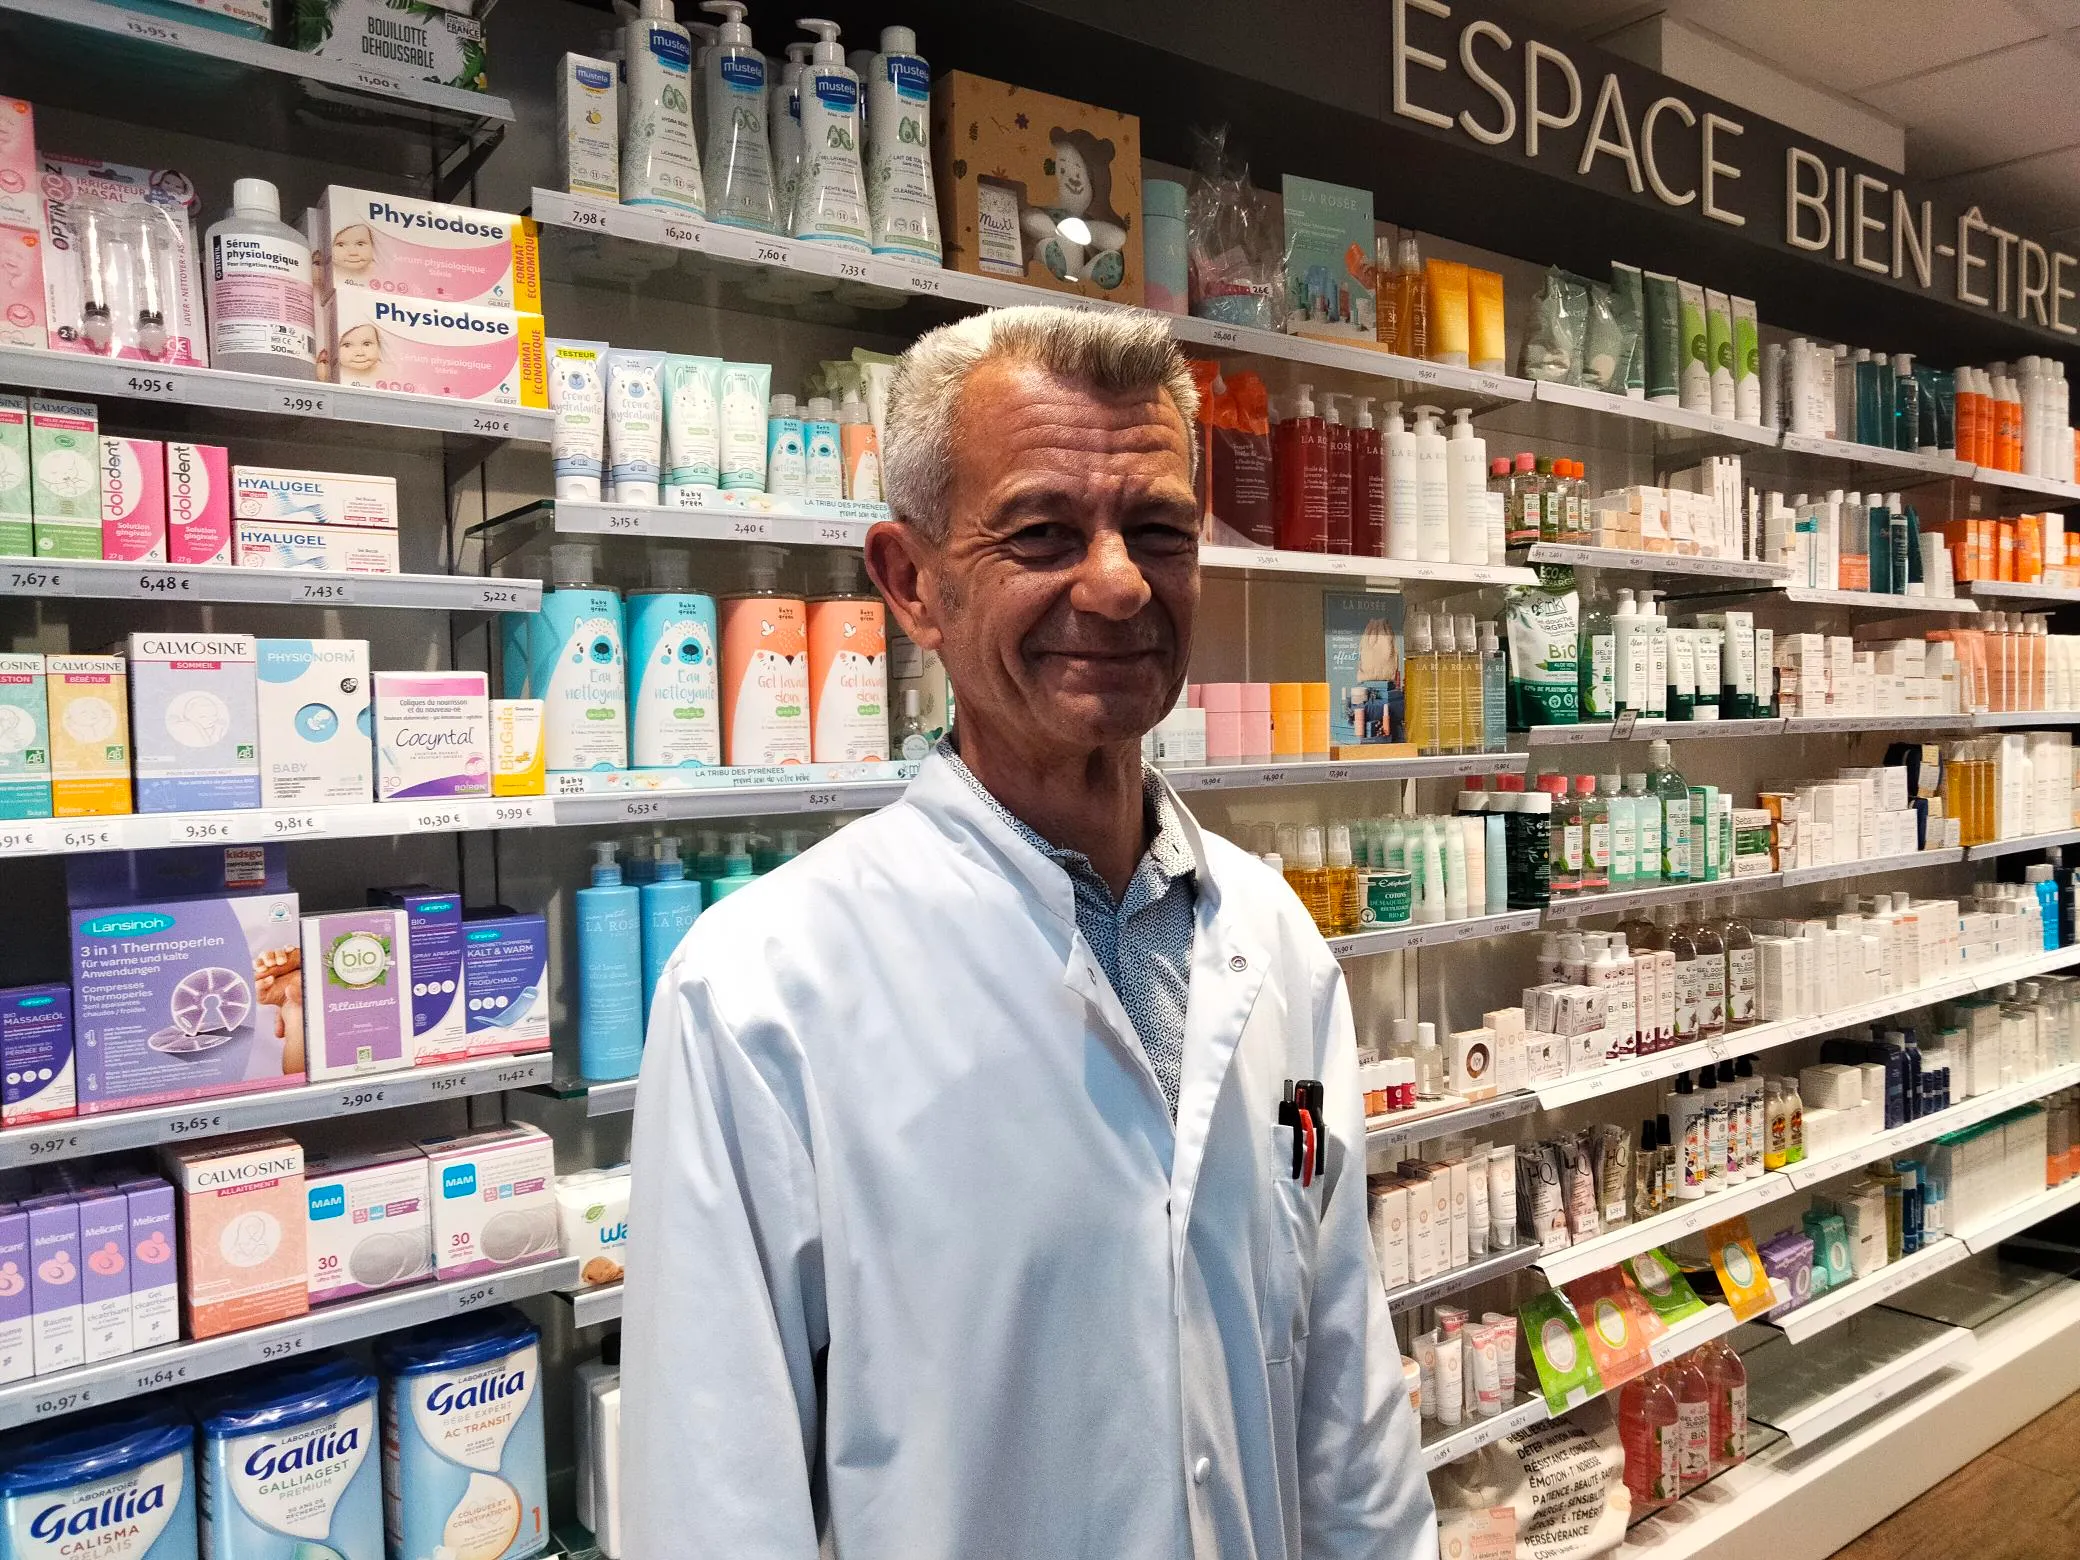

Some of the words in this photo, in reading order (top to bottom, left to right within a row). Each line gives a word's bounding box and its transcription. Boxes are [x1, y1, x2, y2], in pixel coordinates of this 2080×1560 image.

[368, 16, 428, 47] BOUILLOTTE
[447, 22, 480, 39] FRANCE
[362, 36, 435, 69] DEHOUSSABLE
[578, 69, 608, 82] mustela
[723, 61, 763, 78] mustela
[818, 81, 856, 96] mustela
[1393, 0, 1746, 227] ESPACE
[1786, 146, 2080, 335] BIEN-ÊTRE
[77, 178, 146, 197] IRRIGATEUR
[78, 186, 127, 204] NASAL
[369, 202, 503, 239] Physiodose
[572, 210, 597, 225] 7,98
[665, 228, 692, 243] 16,20
[226, 239, 260, 250] Sérum
[227, 249, 299, 267] physiologique
[758, 248, 778, 262] 7,60
[516, 244, 525, 284] FORMAT
[527, 232, 537, 299] ÉCONOMIQUE
[376, 303, 509, 336] Physiodose
[523, 343, 531, 381] FORMAT
[533, 329, 541, 395] ÉCONOMIQUE
[558, 350, 596, 359] TESTEUR
[128, 377, 161, 393] 4,95
[33, 403, 95, 418] CALMOSINE
[283, 397, 312, 411] 2,99
[473, 419, 499, 431] 2,40
[102, 441, 120, 516] dolodent
[173, 446, 191, 521] dolodent
[238, 478, 324, 494] HYALUGEL
[681, 489, 702, 500] Baby
[610, 516, 630, 528] 3,15
[734, 523, 755, 534] 2,40
[241, 531, 327, 546] HYALUGEL
[821, 529, 840, 539] 2,25
[12, 574, 46, 587] 7,67
[140, 577, 176, 591] 6,48
[304, 585, 333, 598] 7,43
[483, 591, 508, 603] 5,22
[143, 641, 248, 656] CALMOSINE
[267, 652, 355, 664] PHYSIONORM
[1333, 651, 1358, 664] offert
[52, 661, 122, 672] CALMOSINE
[176, 662, 215, 670] SOMMEIL
[396, 727, 475, 751] Cocyntal
[498, 706, 515, 771] BioGaia
[560, 776, 583, 789] Baby
[809, 794, 829, 805] 8,25
[496, 808, 523, 820] 9,99
[627, 802, 650, 815] 6,53
[274, 818, 302, 832] 9,81
[418, 815, 450, 827] 10,30
[186, 825, 216, 837] 9,36
[65, 833, 95, 845] 6,15
[226, 849, 263, 860] kidsgo
[92, 917, 165, 933] Lansinoh
[81, 945, 91, 957] 3
[94, 945, 107, 956] in
[111, 943, 118, 955] 1
[121, 935, 224, 957] Thermoperlen
[467, 947, 492, 957] KALT
[493, 946, 502, 955] &
[503, 944, 534, 954] WARM
[82, 957, 98, 969] für
[100, 957, 138, 968] warme
[140, 954, 161, 964] und
[163, 951, 188, 962] kalte
[342, 950, 377, 968] bio
[82, 965, 160, 980] Anwendungen
[82, 982, 145, 995] Compresses
[83, 989, 153, 1003] Thermoperles
[328, 996, 396, 1013] Allaitement
[4, 1011, 66, 1026] MASSAGEÖL
[498, 1070, 525, 1081] 11,42
[432, 1078, 457, 1089] 11,51
[342, 1092, 373, 1106] 2,90
[170, 1115, 208, 1132] 13,65
[30, 1139, 64, 1155] 9,97
[198, 1157, 297, 1186] CALMOSINE
[221, 1180, 276, 1197] ALLAITEMENT
[446, 1175, 474, 1188] MAM
[312, 1196, 343, 1209] MAM
[133, 1214, 170, 1228] Melicare
[85, 1223, 124, 1237] Melicare
[35, 1231, 76, 1246] Melicare
[451, 1232, 470, 1246] 30
[318, 1255, 338, 1269] 30
[459, 1289, 485, 1307] 5,50
[264, 1341, 292, 1358] 9,23
[137, 1368, 173, 1388] 11,64
[458, 1366, 506, 1384] LABORATOIRE
[427, 1370, 525, 1415] Gallia
[36, 1394, 77, 1414] 10,97
[474, 1401, 512, 1419] EXPERT
[444, 1427, 461, 1439] AC
[464, 1413, 513, 1434] TRANSIT
[281, 1423, 338, 1445] LABORATOIRE
[245, 1428, 359, 1480] Gallia
[259, 1459, 350, 1495] GALLIAGEST
[1529, 1471, 1567, 1489] ÉMOTION
[72, 1479, 139, 1505] LABORATOIRE
[279, 1477, 333, 1501] PREMIUM
[1532, 1485, 1570, 1505] PATIENCE
[30, 1484, 164, 1544] Gallia
[531, 1506, 541, 1533] 1
[61, 1526, 139, 1556] CALISMA
[1524, 1524, 1589, 1547] PERSÉVÉRANCE
